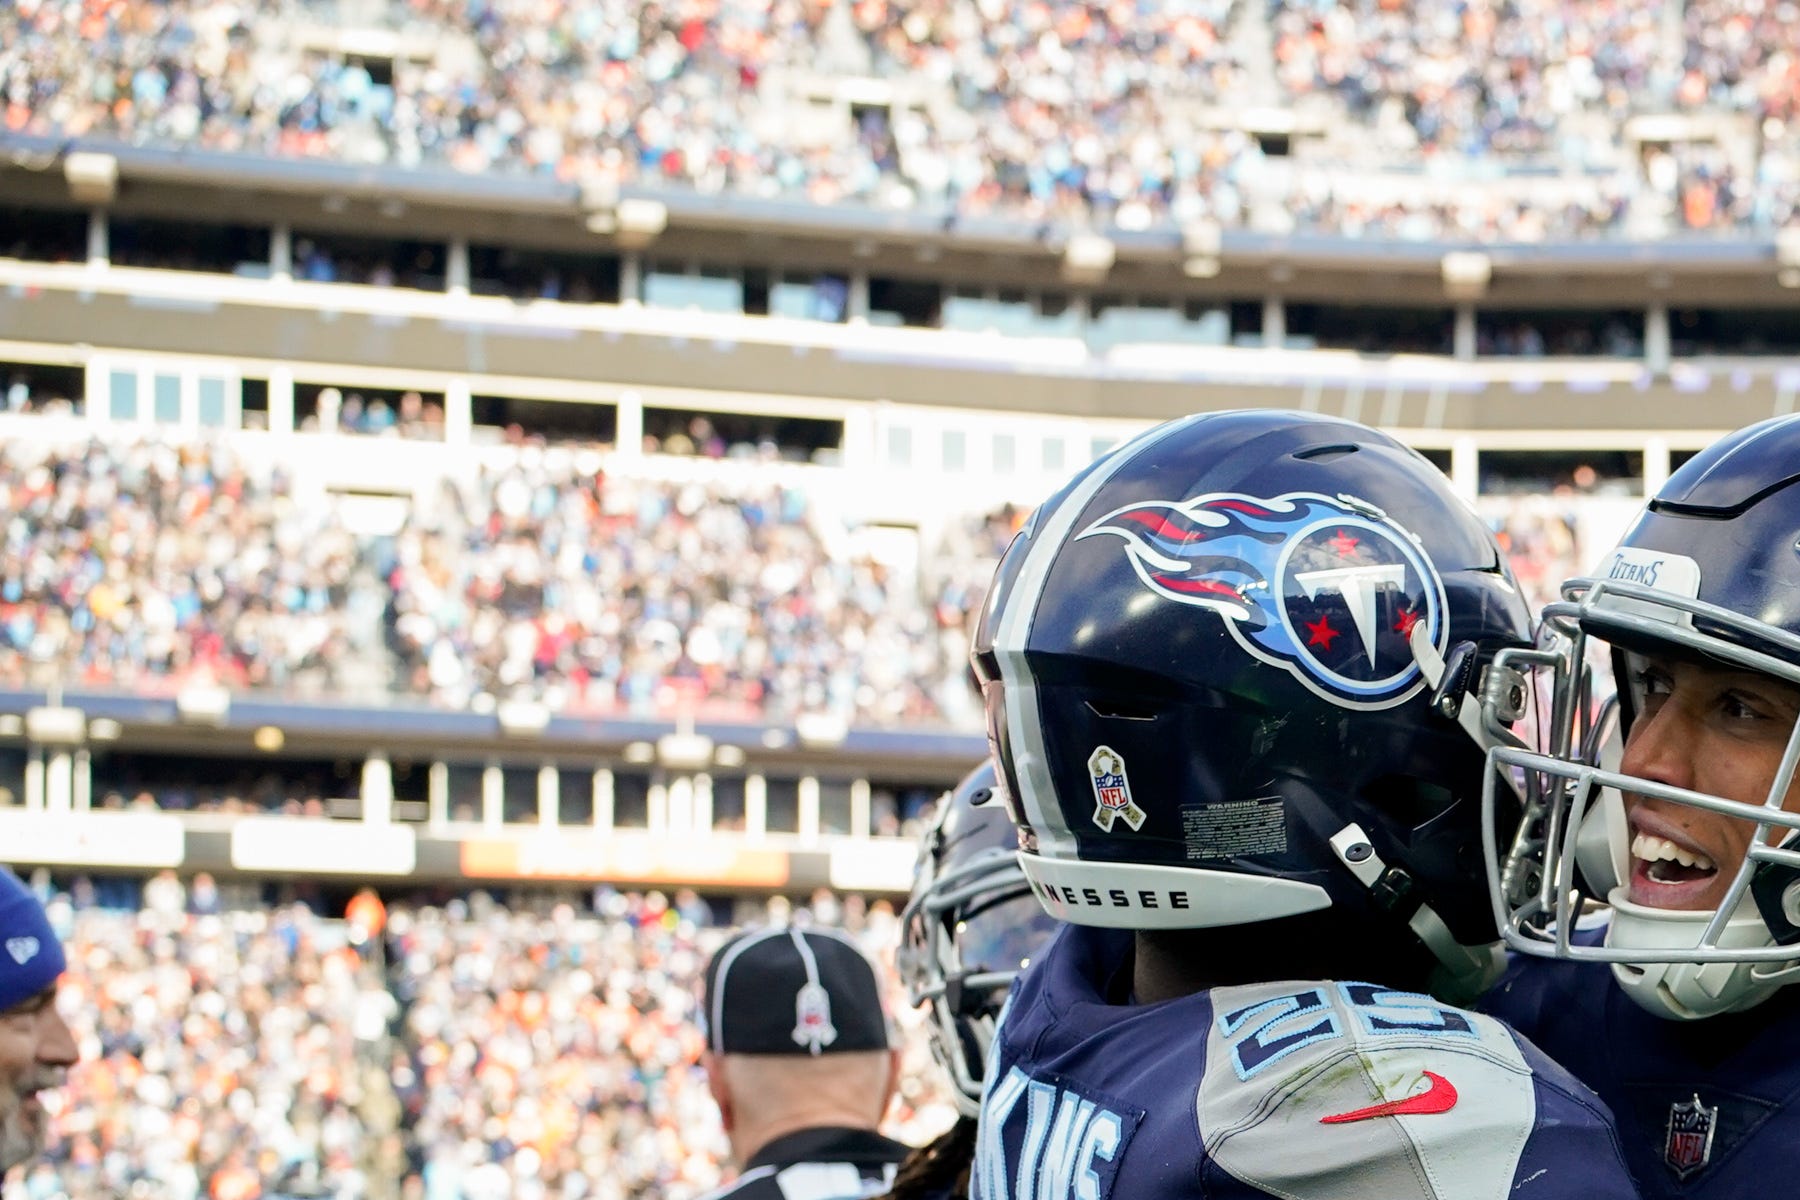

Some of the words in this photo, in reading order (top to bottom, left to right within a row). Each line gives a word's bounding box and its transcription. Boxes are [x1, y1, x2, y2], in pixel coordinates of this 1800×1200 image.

[1609, 553, 1664, 587] TITANS
[1101, 788, 1127, 807] NFL
[1206, 800, 1260, 810] WARNING
[1218, 980, 1481, 1082] 25
[1672, 1131, 1703, 1165] NFL
